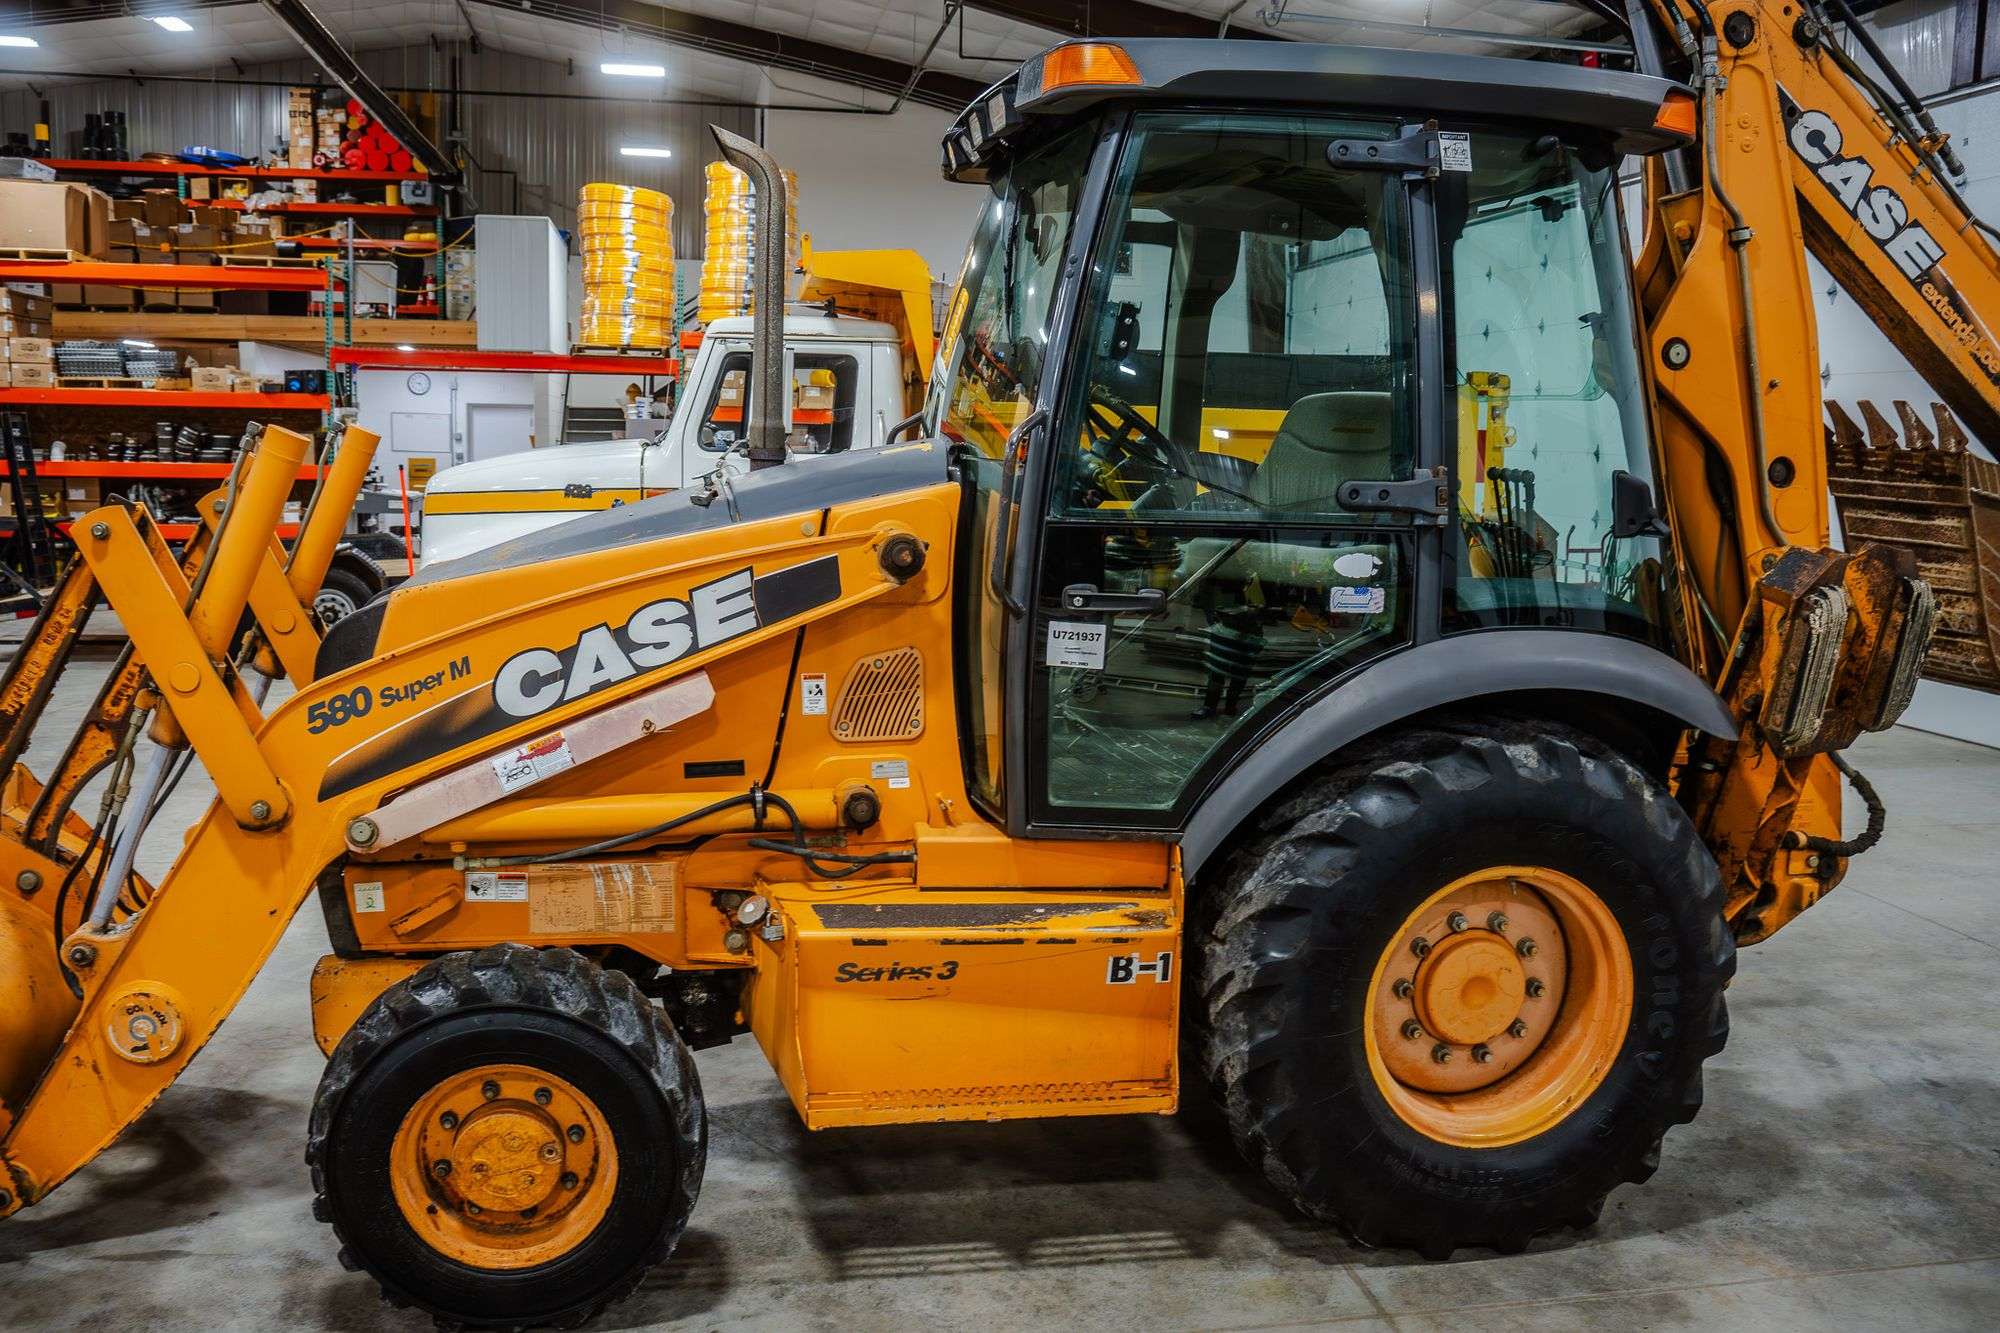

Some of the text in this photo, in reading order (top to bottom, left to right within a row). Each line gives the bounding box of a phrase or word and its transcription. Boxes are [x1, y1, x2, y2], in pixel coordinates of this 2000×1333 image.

[1790, 109, 1946, 280] CASE
[493, 566, 759, 717] CASE
[1053, 630, 1102, 642] U721937
[307, 655, 471, 734] 580 Super M
[835, 961, 959, 982] Series 3
[1110, 953, 1171, 982] B-1
